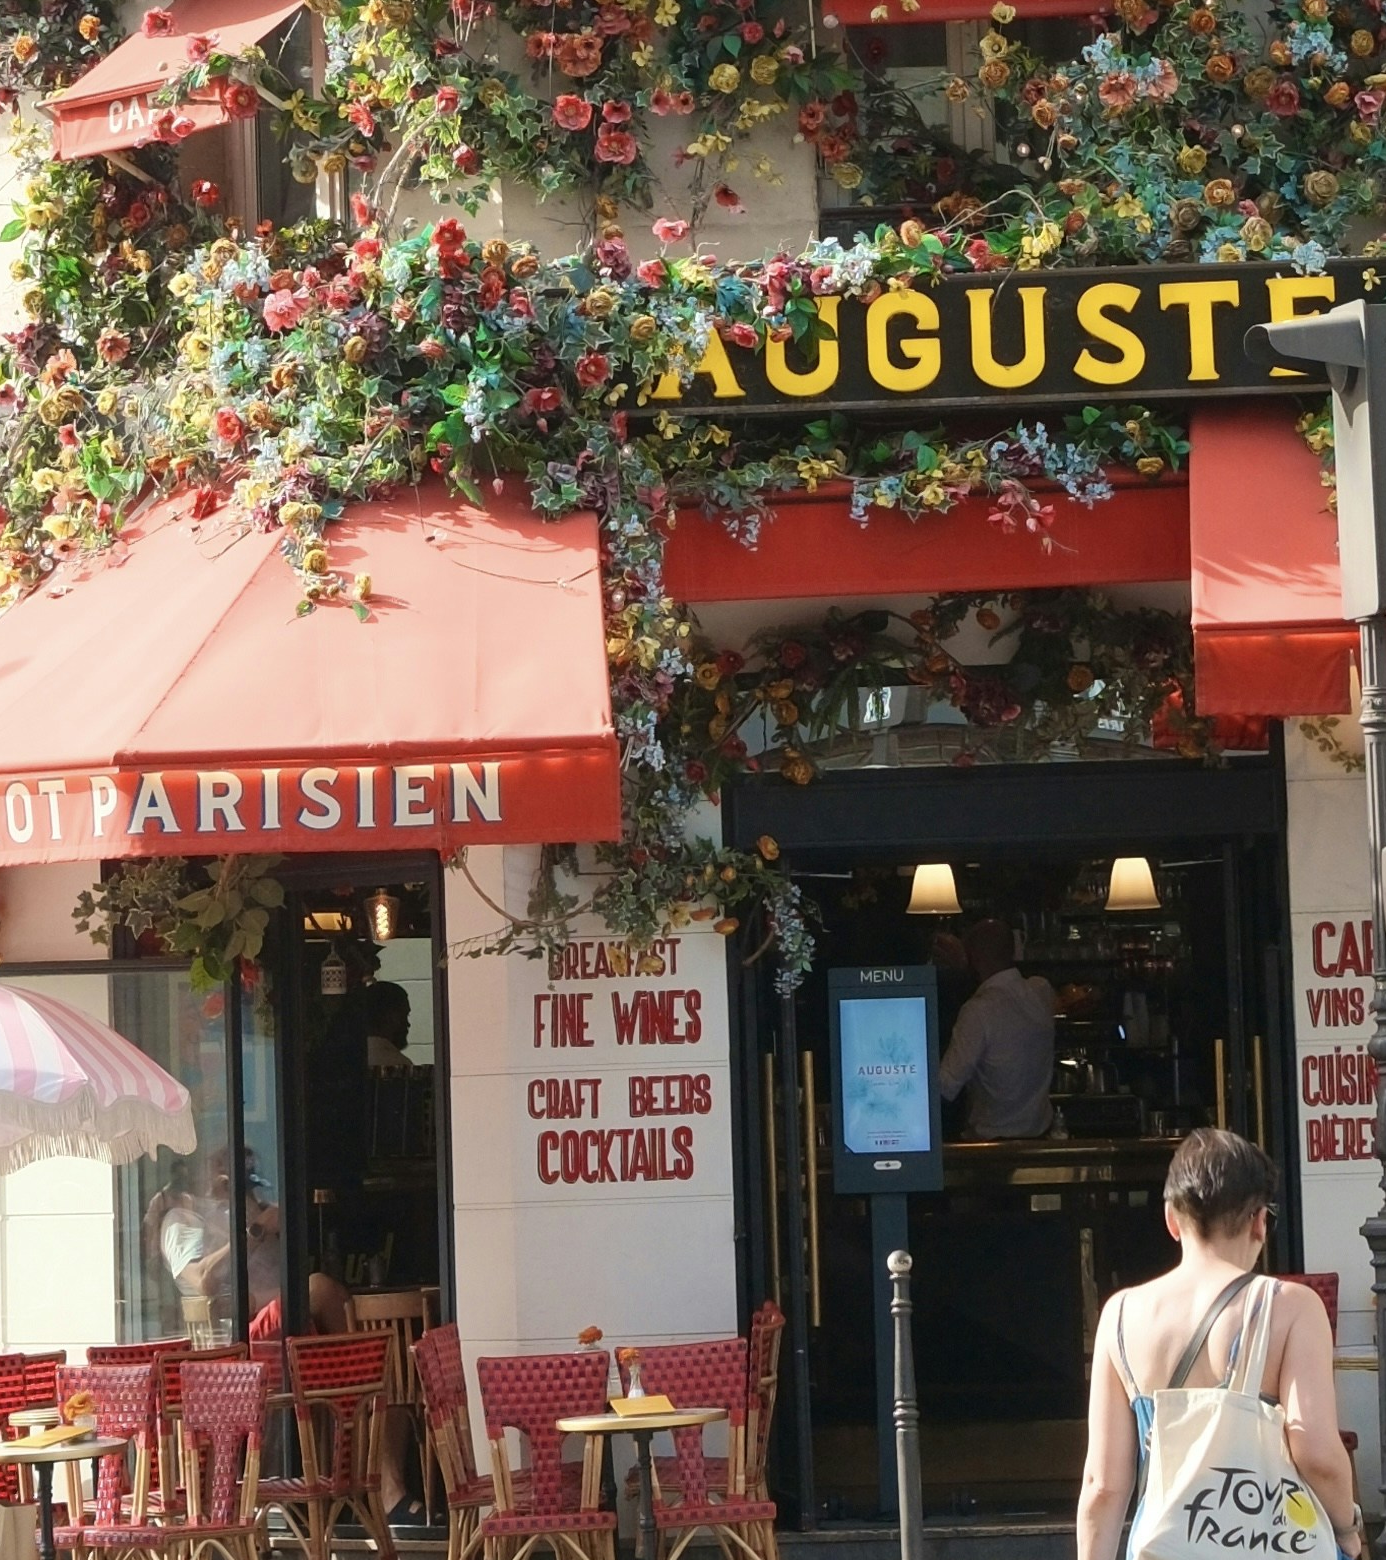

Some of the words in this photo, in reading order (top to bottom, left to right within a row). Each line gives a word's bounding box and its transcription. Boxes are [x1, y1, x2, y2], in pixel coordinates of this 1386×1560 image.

[90, 760, 503, 838] PARISIEN
[860, 969, 904, 983] MENU
[533, 992, 595, 1048] FINE
[611, 989, 702, 1045] WINES
[1306, 987, 1365, 1028] VINS
[857, 1064, 918, 1076] AUGUSTE
[527, 1078, 602, 1120] CRAFT
[629, 1073, 712, 1118] BEERS
[537, 1125, 695, 1184] COCKTAILS
